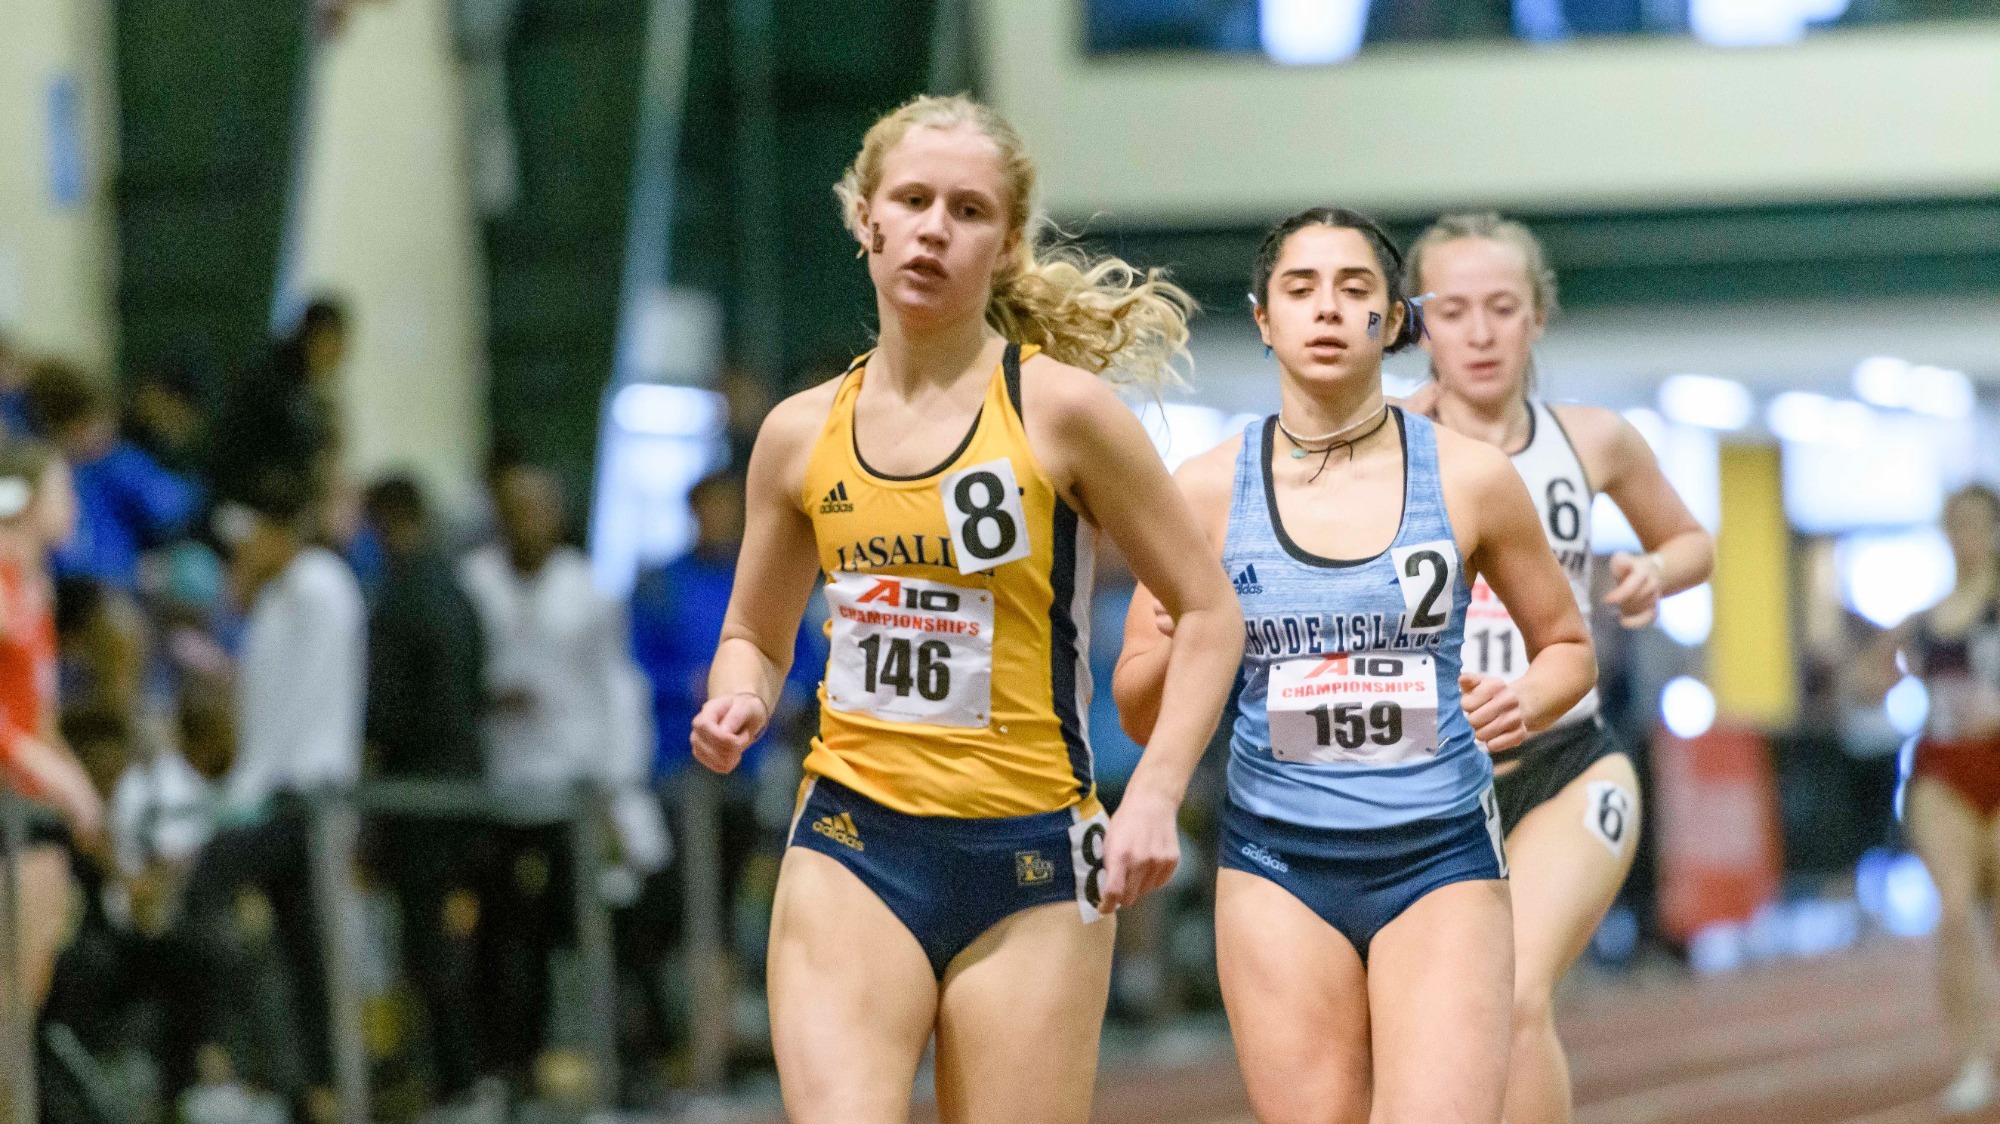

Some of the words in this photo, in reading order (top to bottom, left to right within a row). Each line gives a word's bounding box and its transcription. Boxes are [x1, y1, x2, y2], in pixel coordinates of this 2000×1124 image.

[820, 502, 854, 514] adidas
[954, 470, 1017, 560] 8
[1546, 478, 1580, 541] 6
[836, 534, 995, 577] LASALL
[1404, 549, 1449, 629] 2
[838, 604, 981, 637] CHAMPIONSHIPS
[1244, 615, 1324, 656] HODE
[857, 632, 953, 702] 146
[1472, 629, 1512, 673] 11
[1281, 680, 1426, 699] CHAMPIONSHIPS
[1304, 700, 1404, 750] 159
[812, 820, 865, 852] adidas
[1599, 787, 1628, 843] 6
[1241, 843, 1289, 874] adidas
